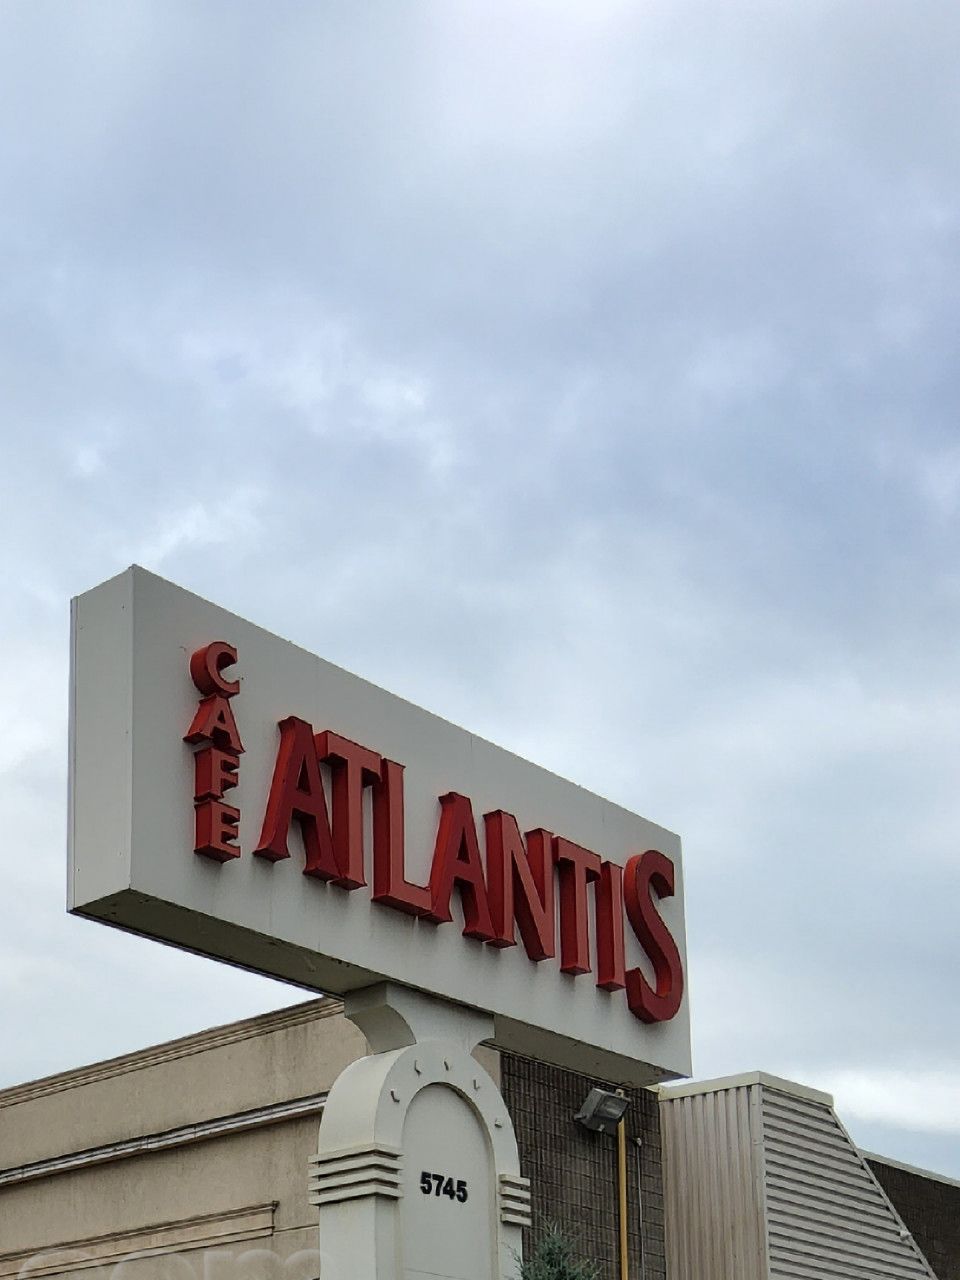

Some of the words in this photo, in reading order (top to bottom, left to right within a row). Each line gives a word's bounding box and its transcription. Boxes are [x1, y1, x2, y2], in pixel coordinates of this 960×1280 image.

[184, 641, 245, 864] CAFE
[252, 715, 683, 1024] ATLANTIS
[420, 1170, 468, 1203] 5745
